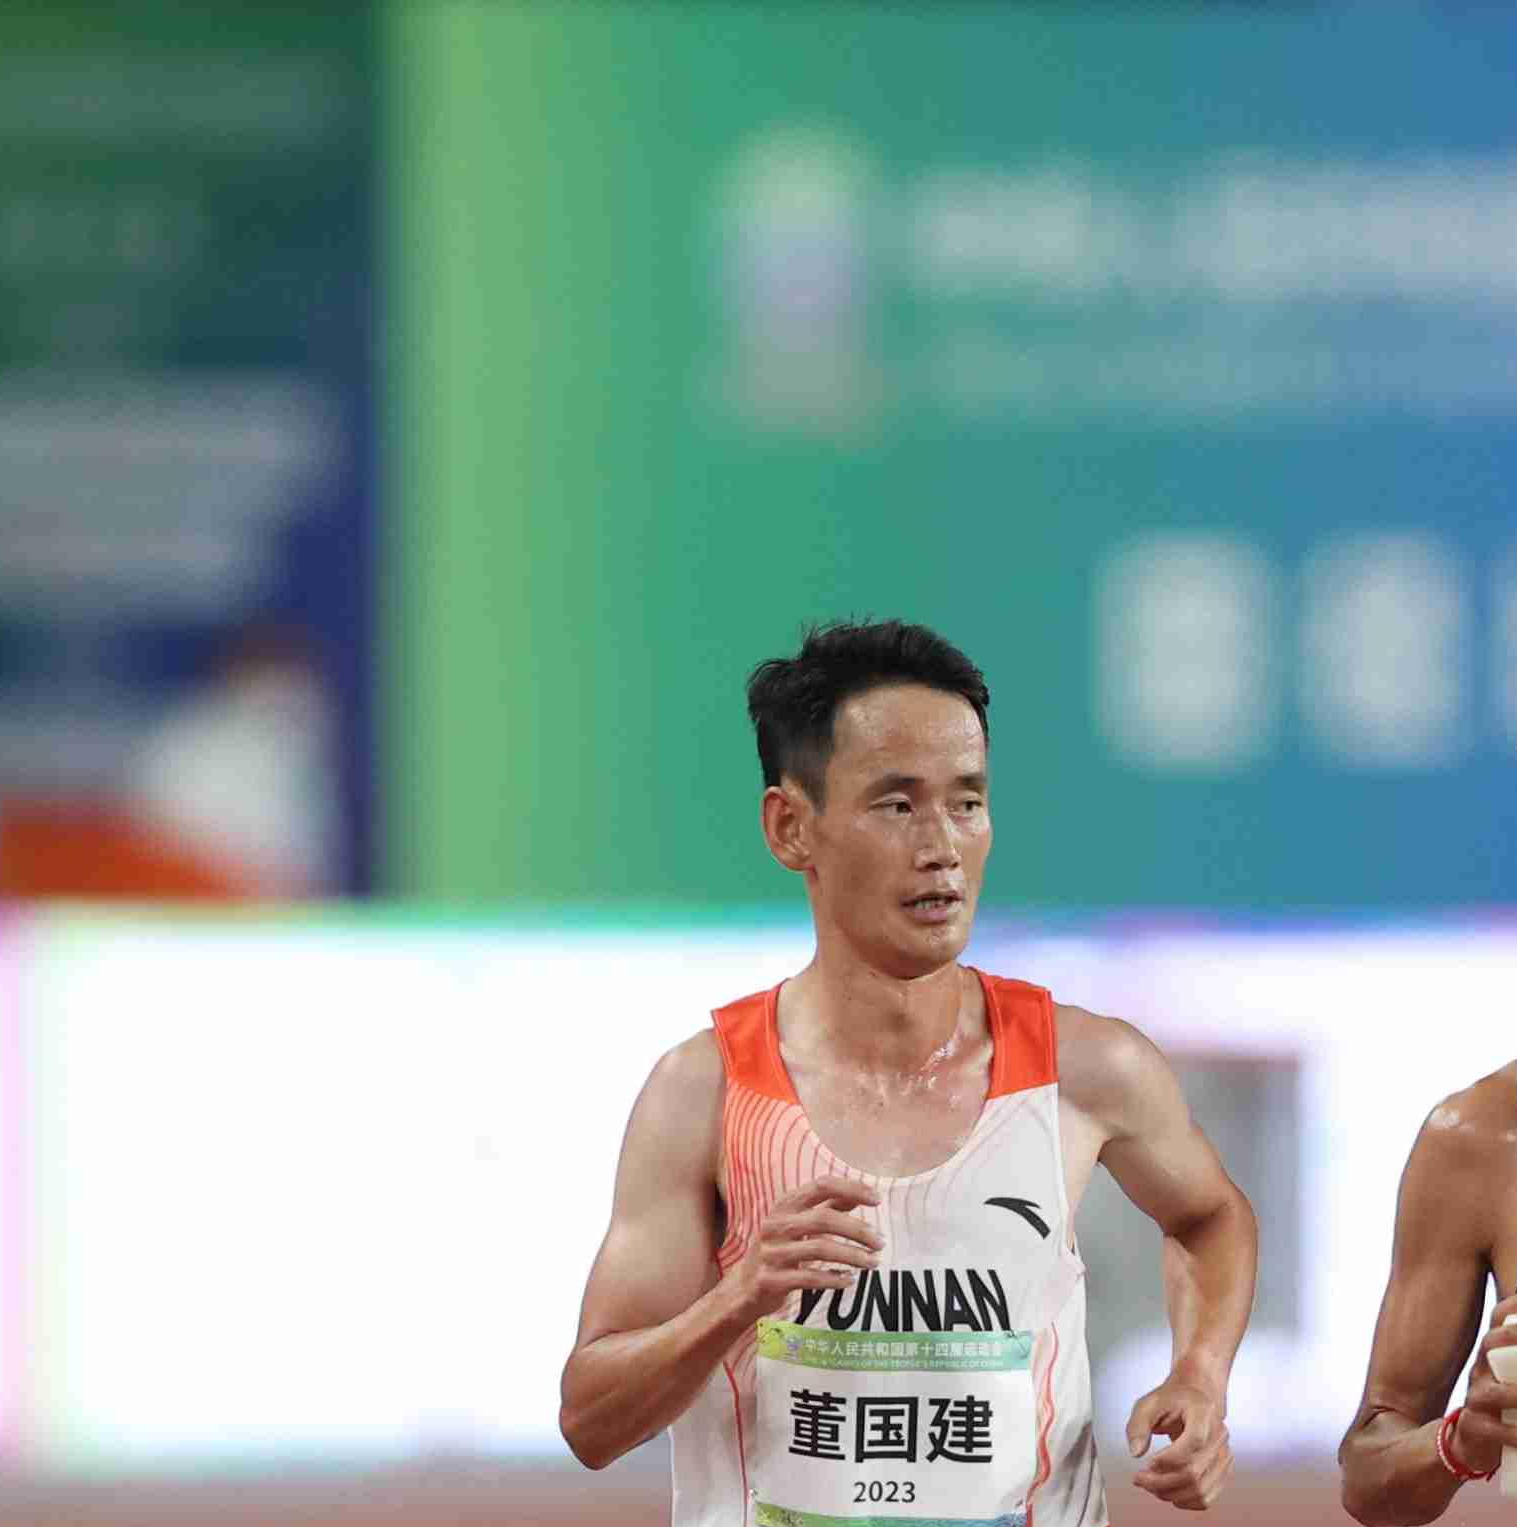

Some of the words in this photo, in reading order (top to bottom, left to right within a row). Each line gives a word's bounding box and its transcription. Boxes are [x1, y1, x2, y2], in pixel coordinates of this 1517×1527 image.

[788, 1389, 993, 1464] 董国建
[852, 1480, 916, 1503] 2023
